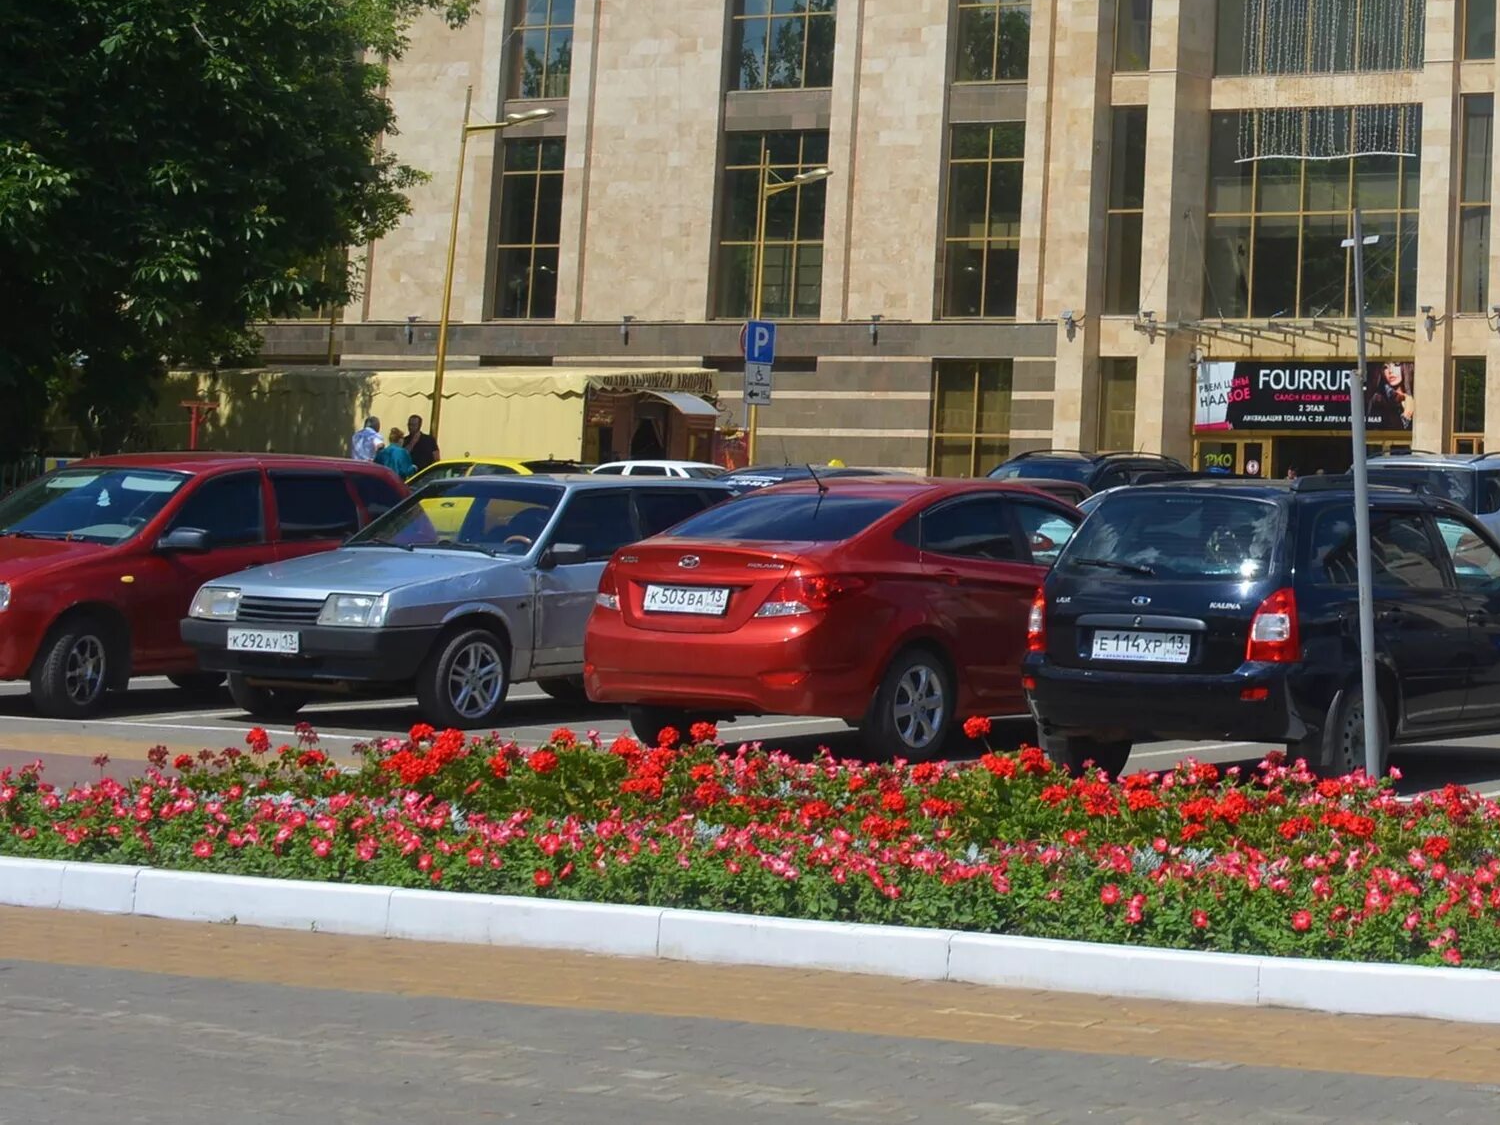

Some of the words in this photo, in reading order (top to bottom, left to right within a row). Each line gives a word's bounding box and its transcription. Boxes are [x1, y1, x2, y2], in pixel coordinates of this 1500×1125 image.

[754, 326, 769, 358] P
[1199, 382, 1222, 394] РВЕМ
[1224, 376, 1250, 389] ЦЕНЫ
[1258, 369, 1367, 390] FOURRUR
[1274, 393, 1299, 401] САЛОН
[1301, 393, 1322, 401] КОЖИ
[1298, 404, 1304, 412] 2
[1305, 404, 1325, 412] ЭТАЖ
[649, 588, 704, 606] К503ВА
[709, 590, 724, 603] 13
[1209, 601, 1241, 610] KALINA
[232, 632, 279, 649] К292АУ
[282, 634, 294, 646] 13
[1100, 634, 1163, 654] Е114ХР
[1168, 635, 1185, 650] 13
